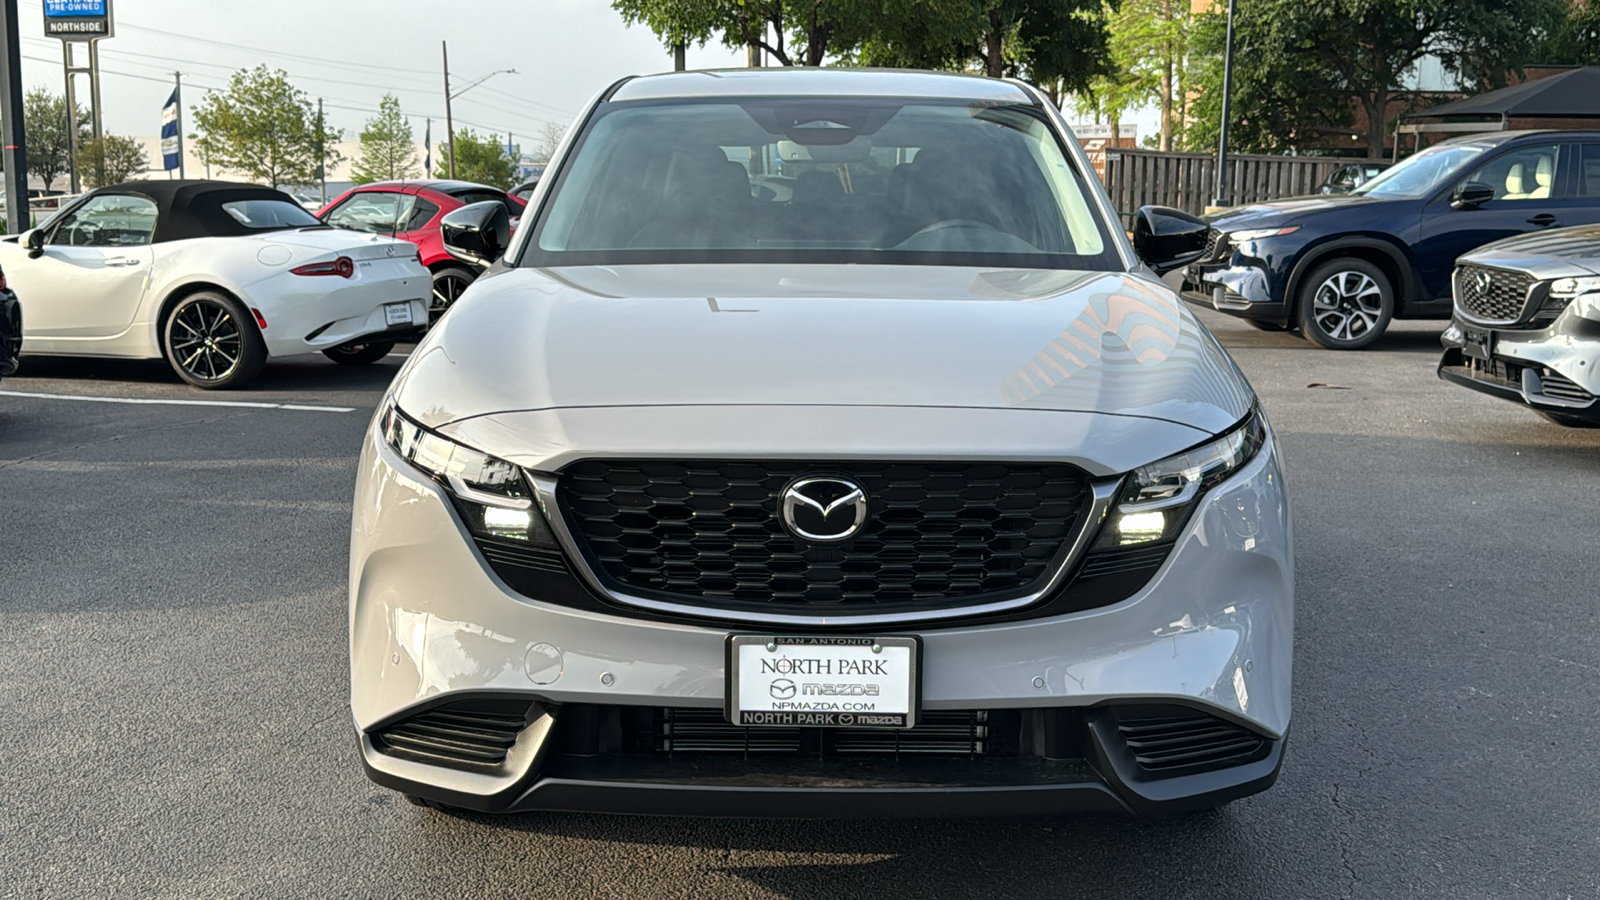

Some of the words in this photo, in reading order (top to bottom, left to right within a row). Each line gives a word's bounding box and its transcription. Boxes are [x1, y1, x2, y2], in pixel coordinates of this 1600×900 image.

[49, 3, 100, 11] PRE-OWNED
[50, 22, 101, 32] NORTHSIDE
[760, 658, 831, 675] NORTH
[838, 659, 889, 675] PARK
[772, 702, 875, 711] NPMAZDA.COM
[743, 712, 792, 724] NORTH
[797, 713, 835, 725] PARK
